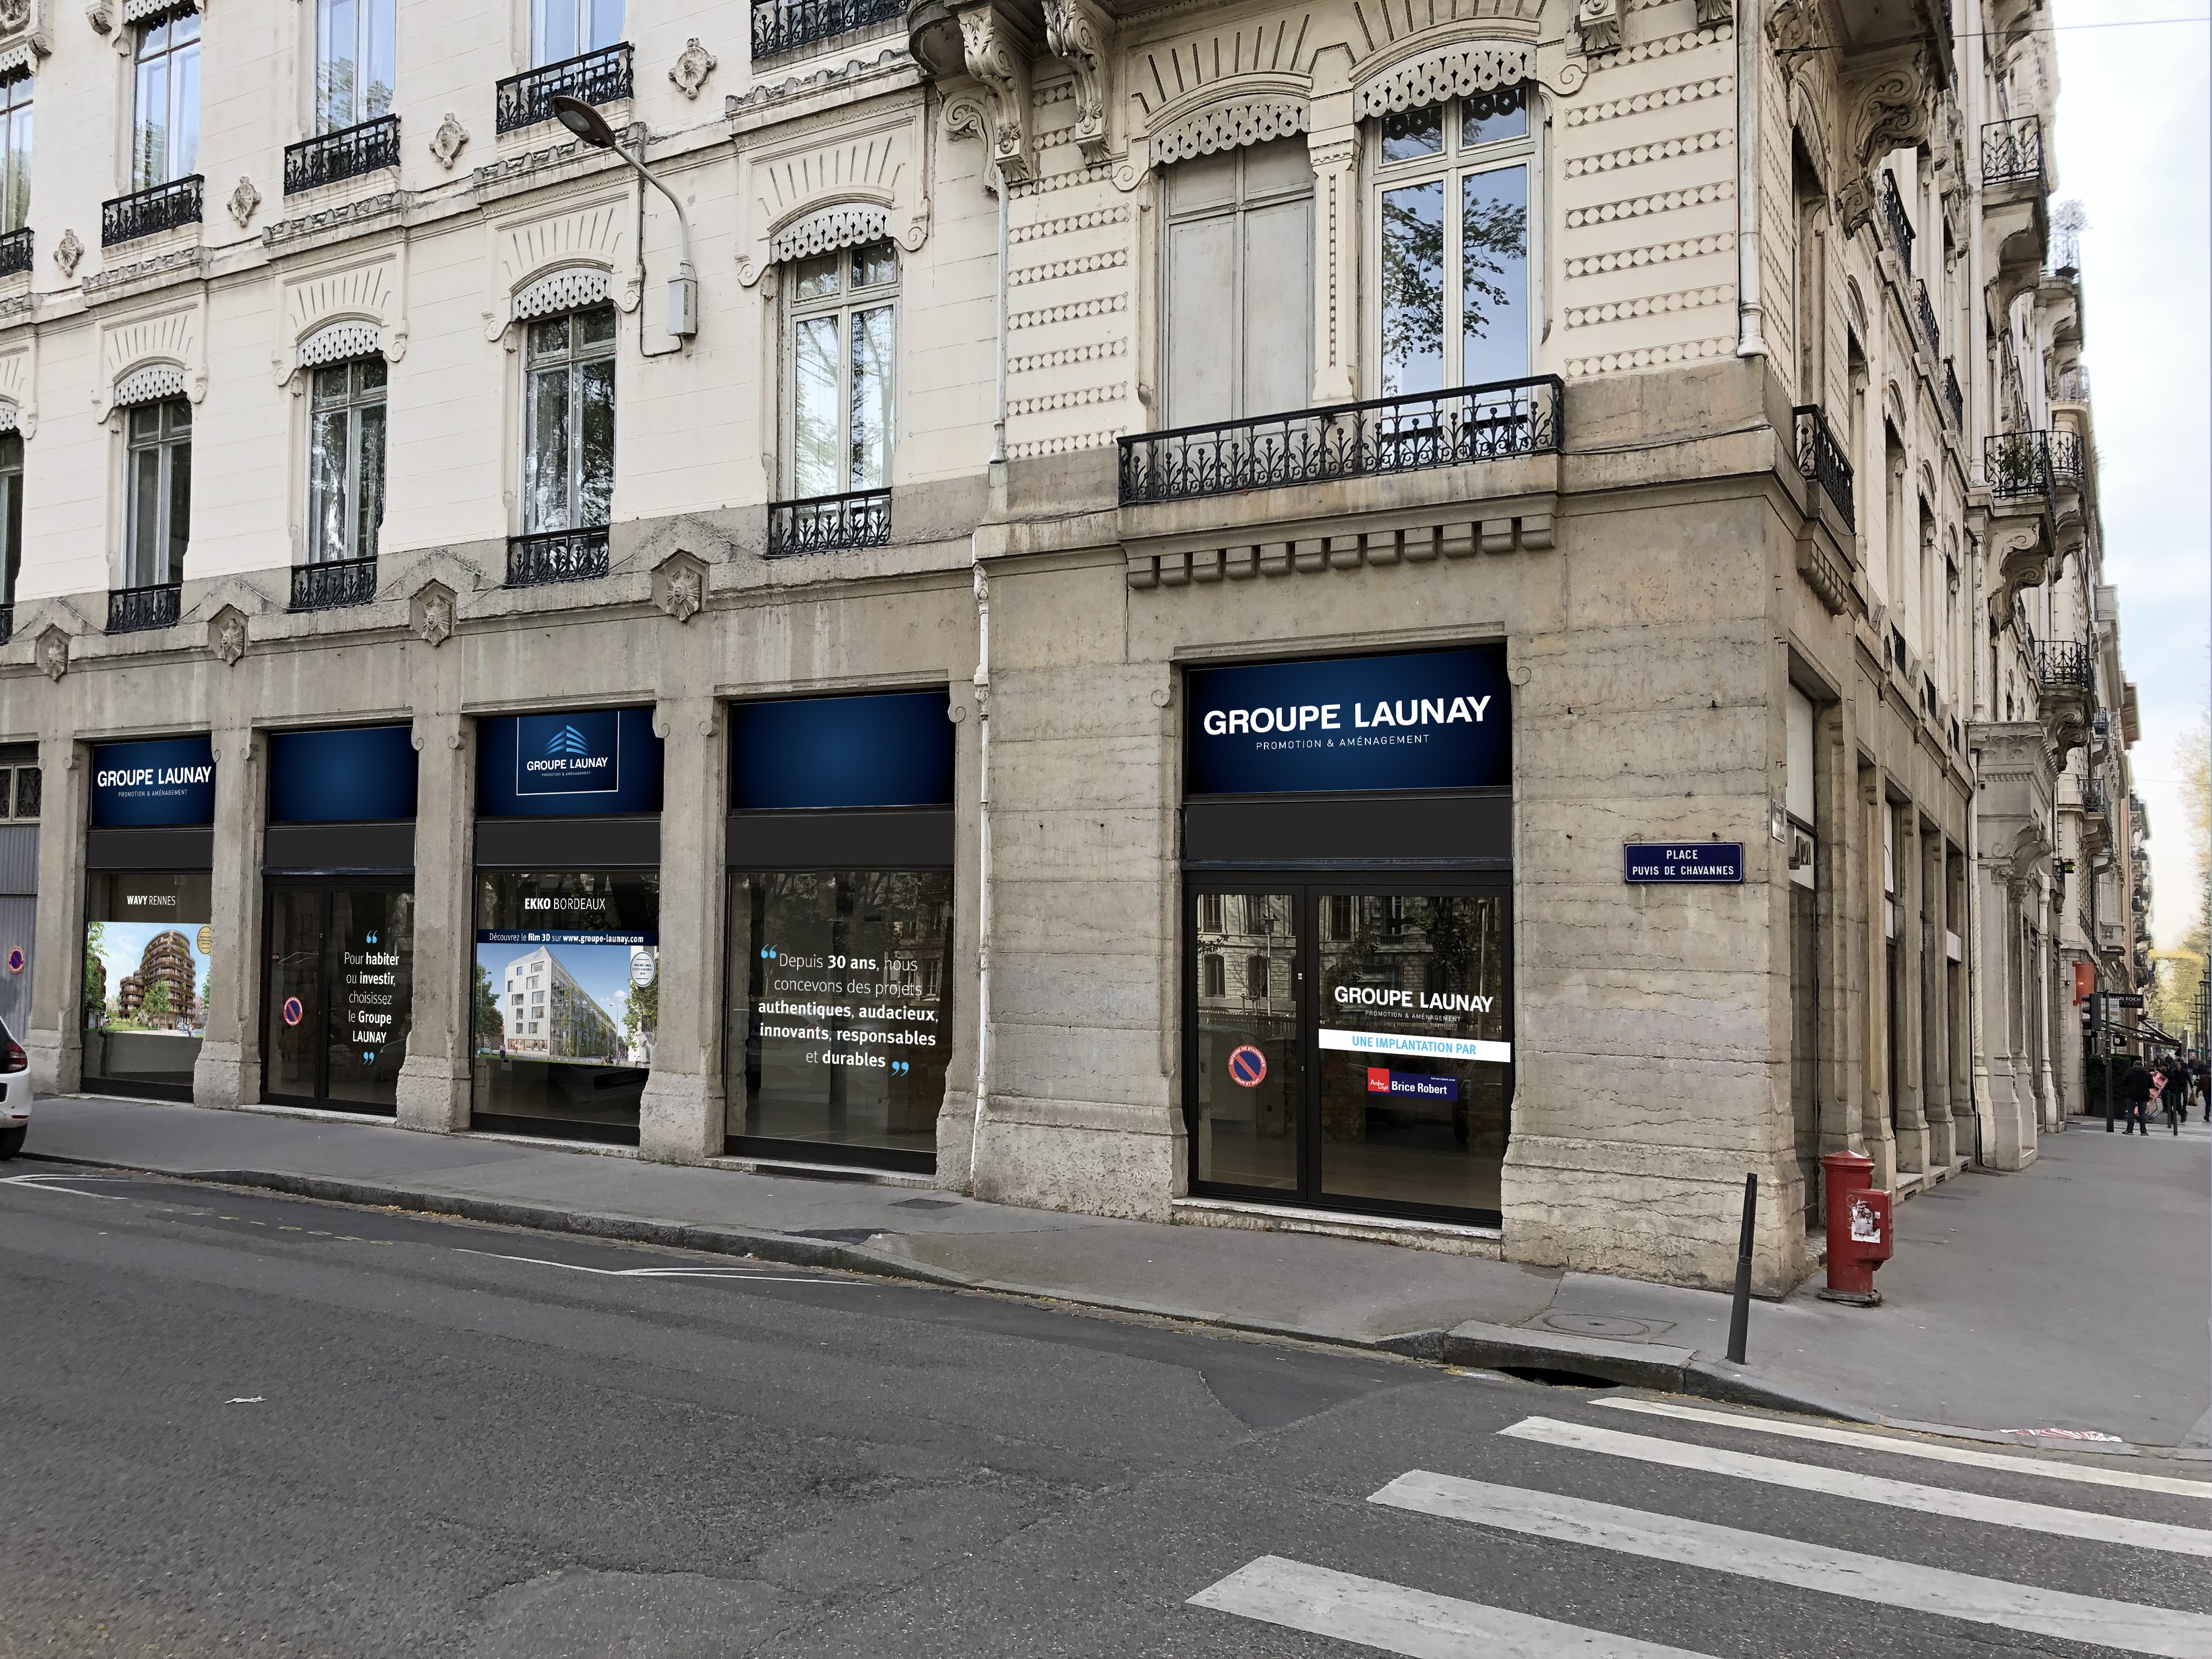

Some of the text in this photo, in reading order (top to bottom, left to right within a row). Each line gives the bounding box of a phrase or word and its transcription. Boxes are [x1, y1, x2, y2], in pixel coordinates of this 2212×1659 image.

[1204, 695, 1491, 735] GROUPE LAUNAY
[1256, 734, 1429, 751] PROMOTION & AMÉNAGEMENT
[527, 757, 608, 771] GROUPE LAUNAY
[97, 766, 212, 787] GROUPE LAUNAY
[1666, 849, 1698, 860] PLACE
[1632, 866, 1734, 875] PUVIS DE CHAVANNES
[127, 895, 176, 906] WAVY RENNES
[524, 898, 606, 910] EKKO BORDEAUX
[489, 933, 520, 941] Découvrez
[521, 933, 527, 941] le
[528, 933, 540, 941] film
[541, 933, 551, 941] 3D
[562, 934, 644, 945] www.groupe-launay.com
[345, 951, 400, 966] Pour habiter
[780, 953, 918, 972] Depuis 30 ans, nous
[346, 971, 396, 987] ou investir,
[774, 979, 922, 998] concevons des projets
[349, 990, 392, 1005] choisissez
[1334, 986, 1494, 1013] GROUPE LAUNAY
[348, 1010, 392, 1027] le Groupe
[758, 1000, 939, 1024] authentiques, audacieux,
[1365, 1010, 1402, 1018] PROMOTION
[1412, 1013, 1461, 1022] AMÉNAGEMENT
[353, 1030, 387, 1043] LAUNAY
[760, 1023, 936, 1046] innovants, responsables
[1352, 1036, 1476, 1055] UNE IMPLANTATION PAR
[806, 1050, 886, 1068] et durables
[1248, 1047, 1266, 1067] STATIONNER
[1234, 1077, 1245, 1085] JOUR
[1251, 1077, 1260, 1085] NUIT
[1391, 1081, 1447, 1094] Brice Robert
